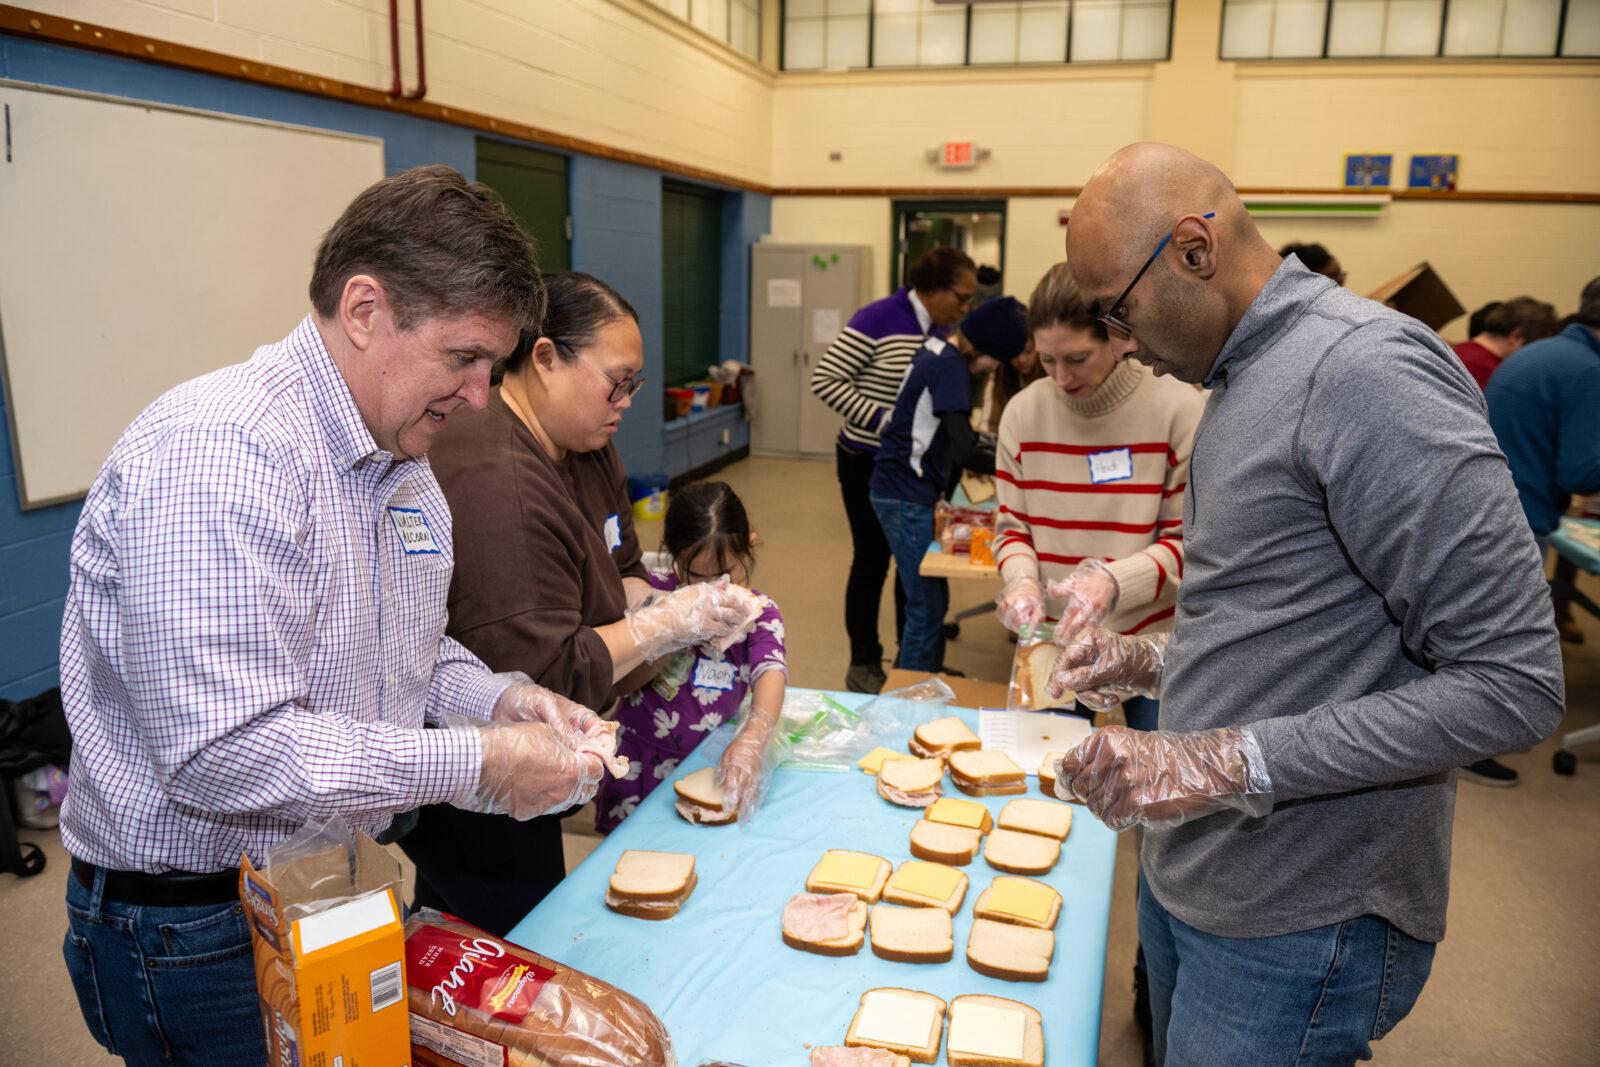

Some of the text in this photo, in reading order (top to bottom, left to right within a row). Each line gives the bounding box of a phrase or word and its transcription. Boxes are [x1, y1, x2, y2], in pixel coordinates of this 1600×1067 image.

[945, 142, 972, 165] EXIT
[394, 515, 426, 529] WALTER
[402, 529, 430, 544] ALCORN
[506, 970, 536, 1008] Wegmans
